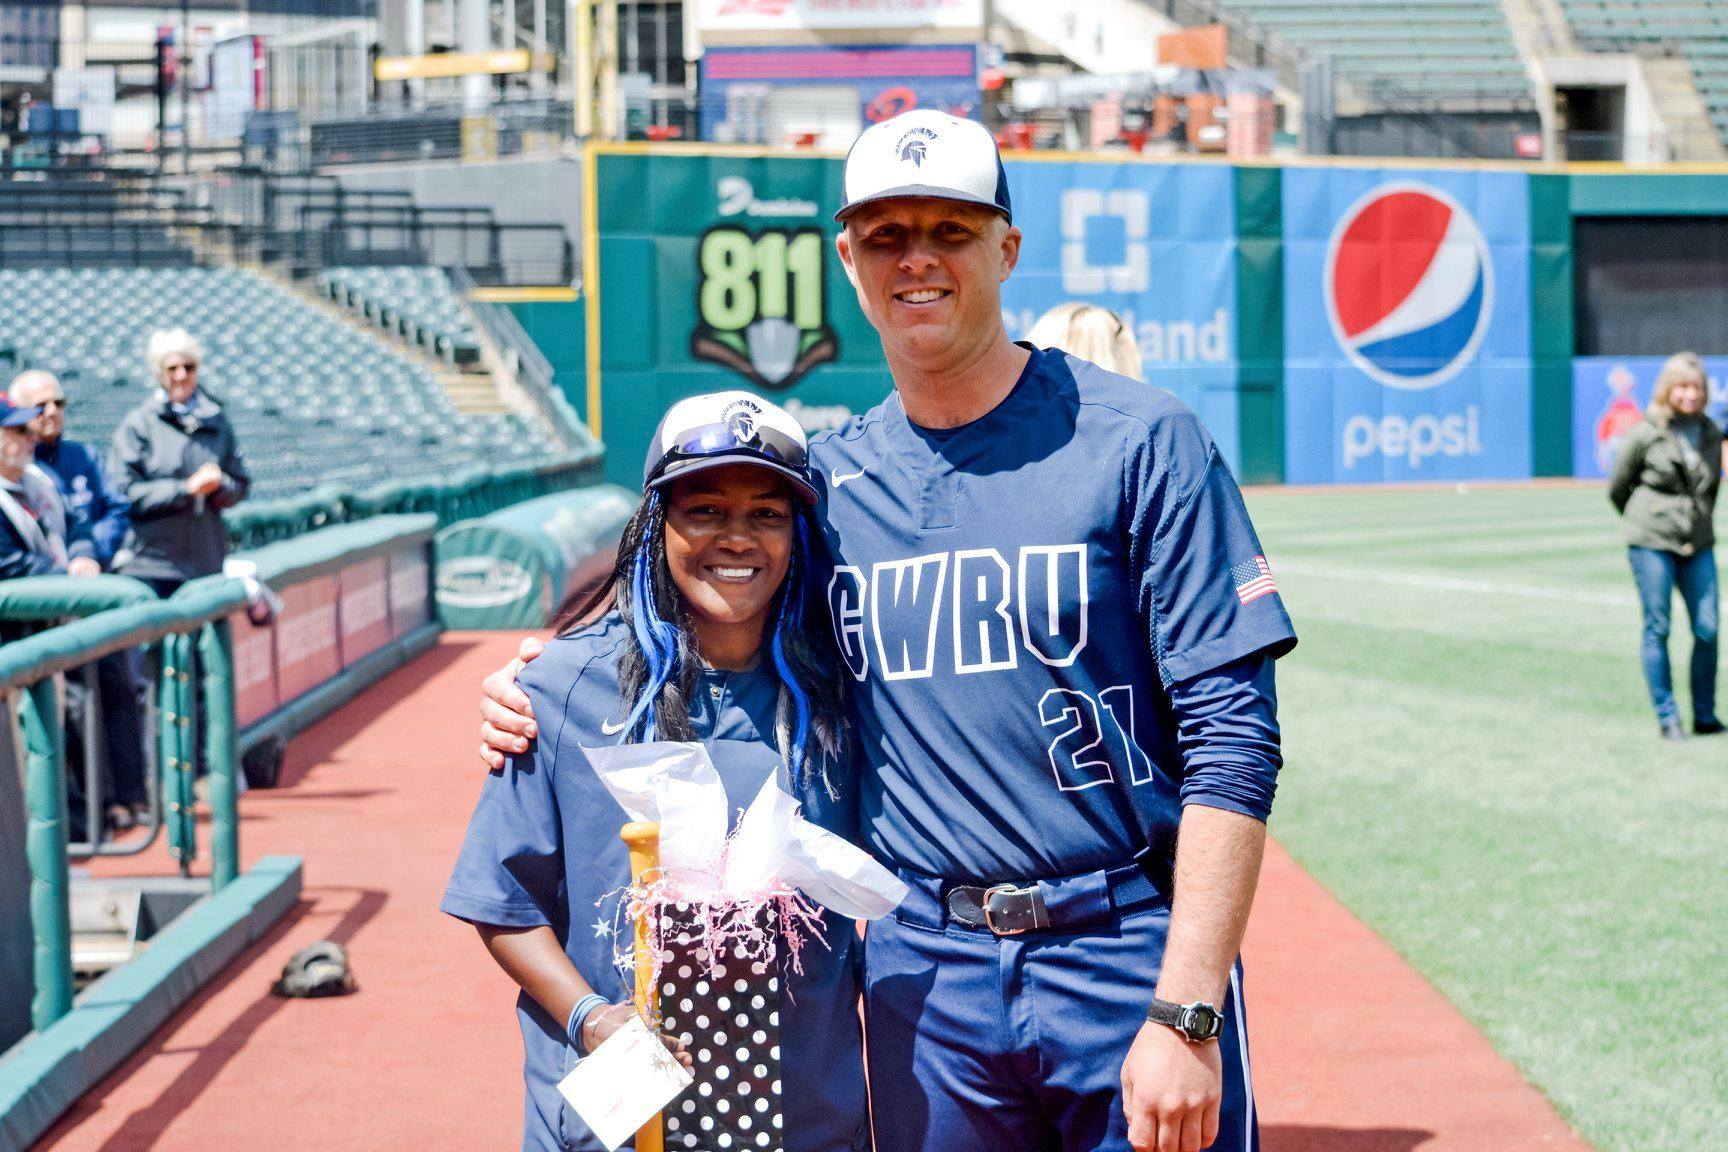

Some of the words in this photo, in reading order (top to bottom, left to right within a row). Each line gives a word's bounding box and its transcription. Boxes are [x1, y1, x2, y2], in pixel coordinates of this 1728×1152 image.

[702, 229, 821, 330] 811
[1343, 405, 1480, 469] pepsi
[828, 543, 1088, 682] CWRU
[1038, 685, 1154, 792] 21
